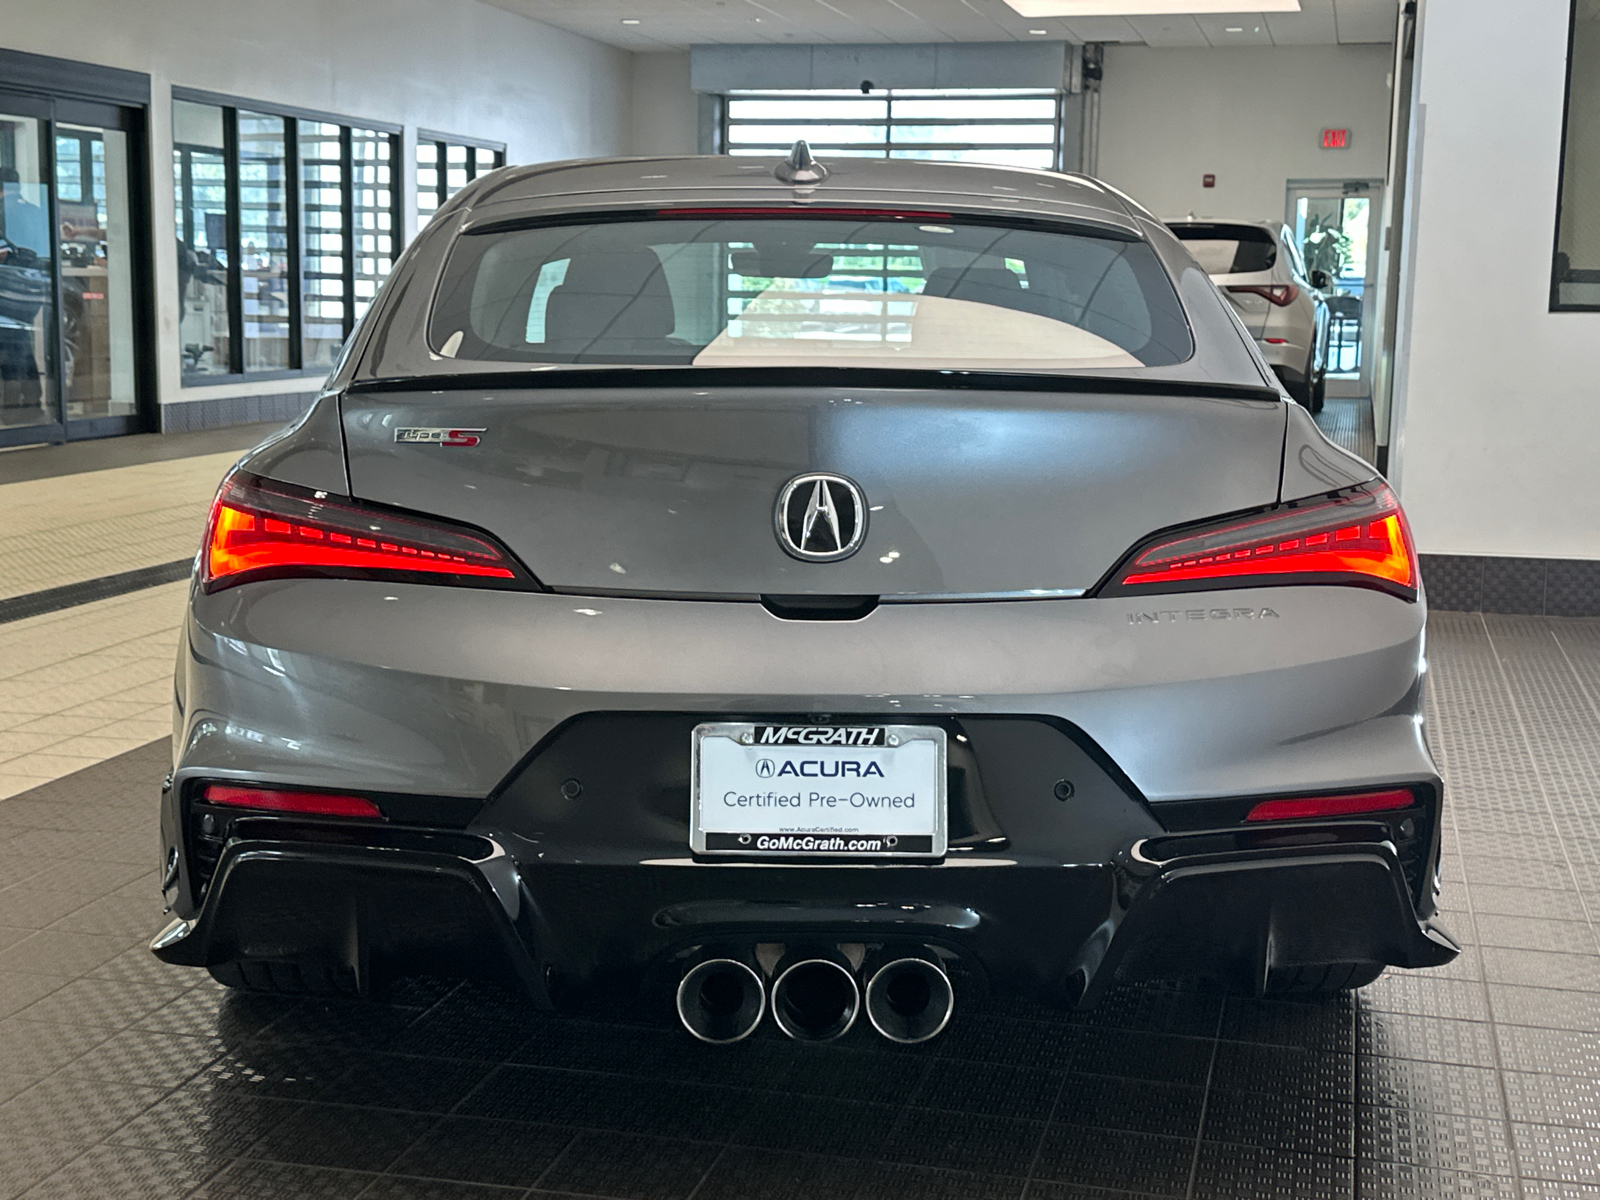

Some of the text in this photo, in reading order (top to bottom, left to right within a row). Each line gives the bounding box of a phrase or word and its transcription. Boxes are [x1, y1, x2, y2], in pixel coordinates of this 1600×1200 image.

[1323, 129, 1347, 148] EXIT
[1126, 607, 1280, 625] INTEGRA
[777, 760, 885, 778] ACURA
[723, 791, 916, 809] Certified Pre-Owned
[756, 836, 882, 851] GoMcGrath.com
